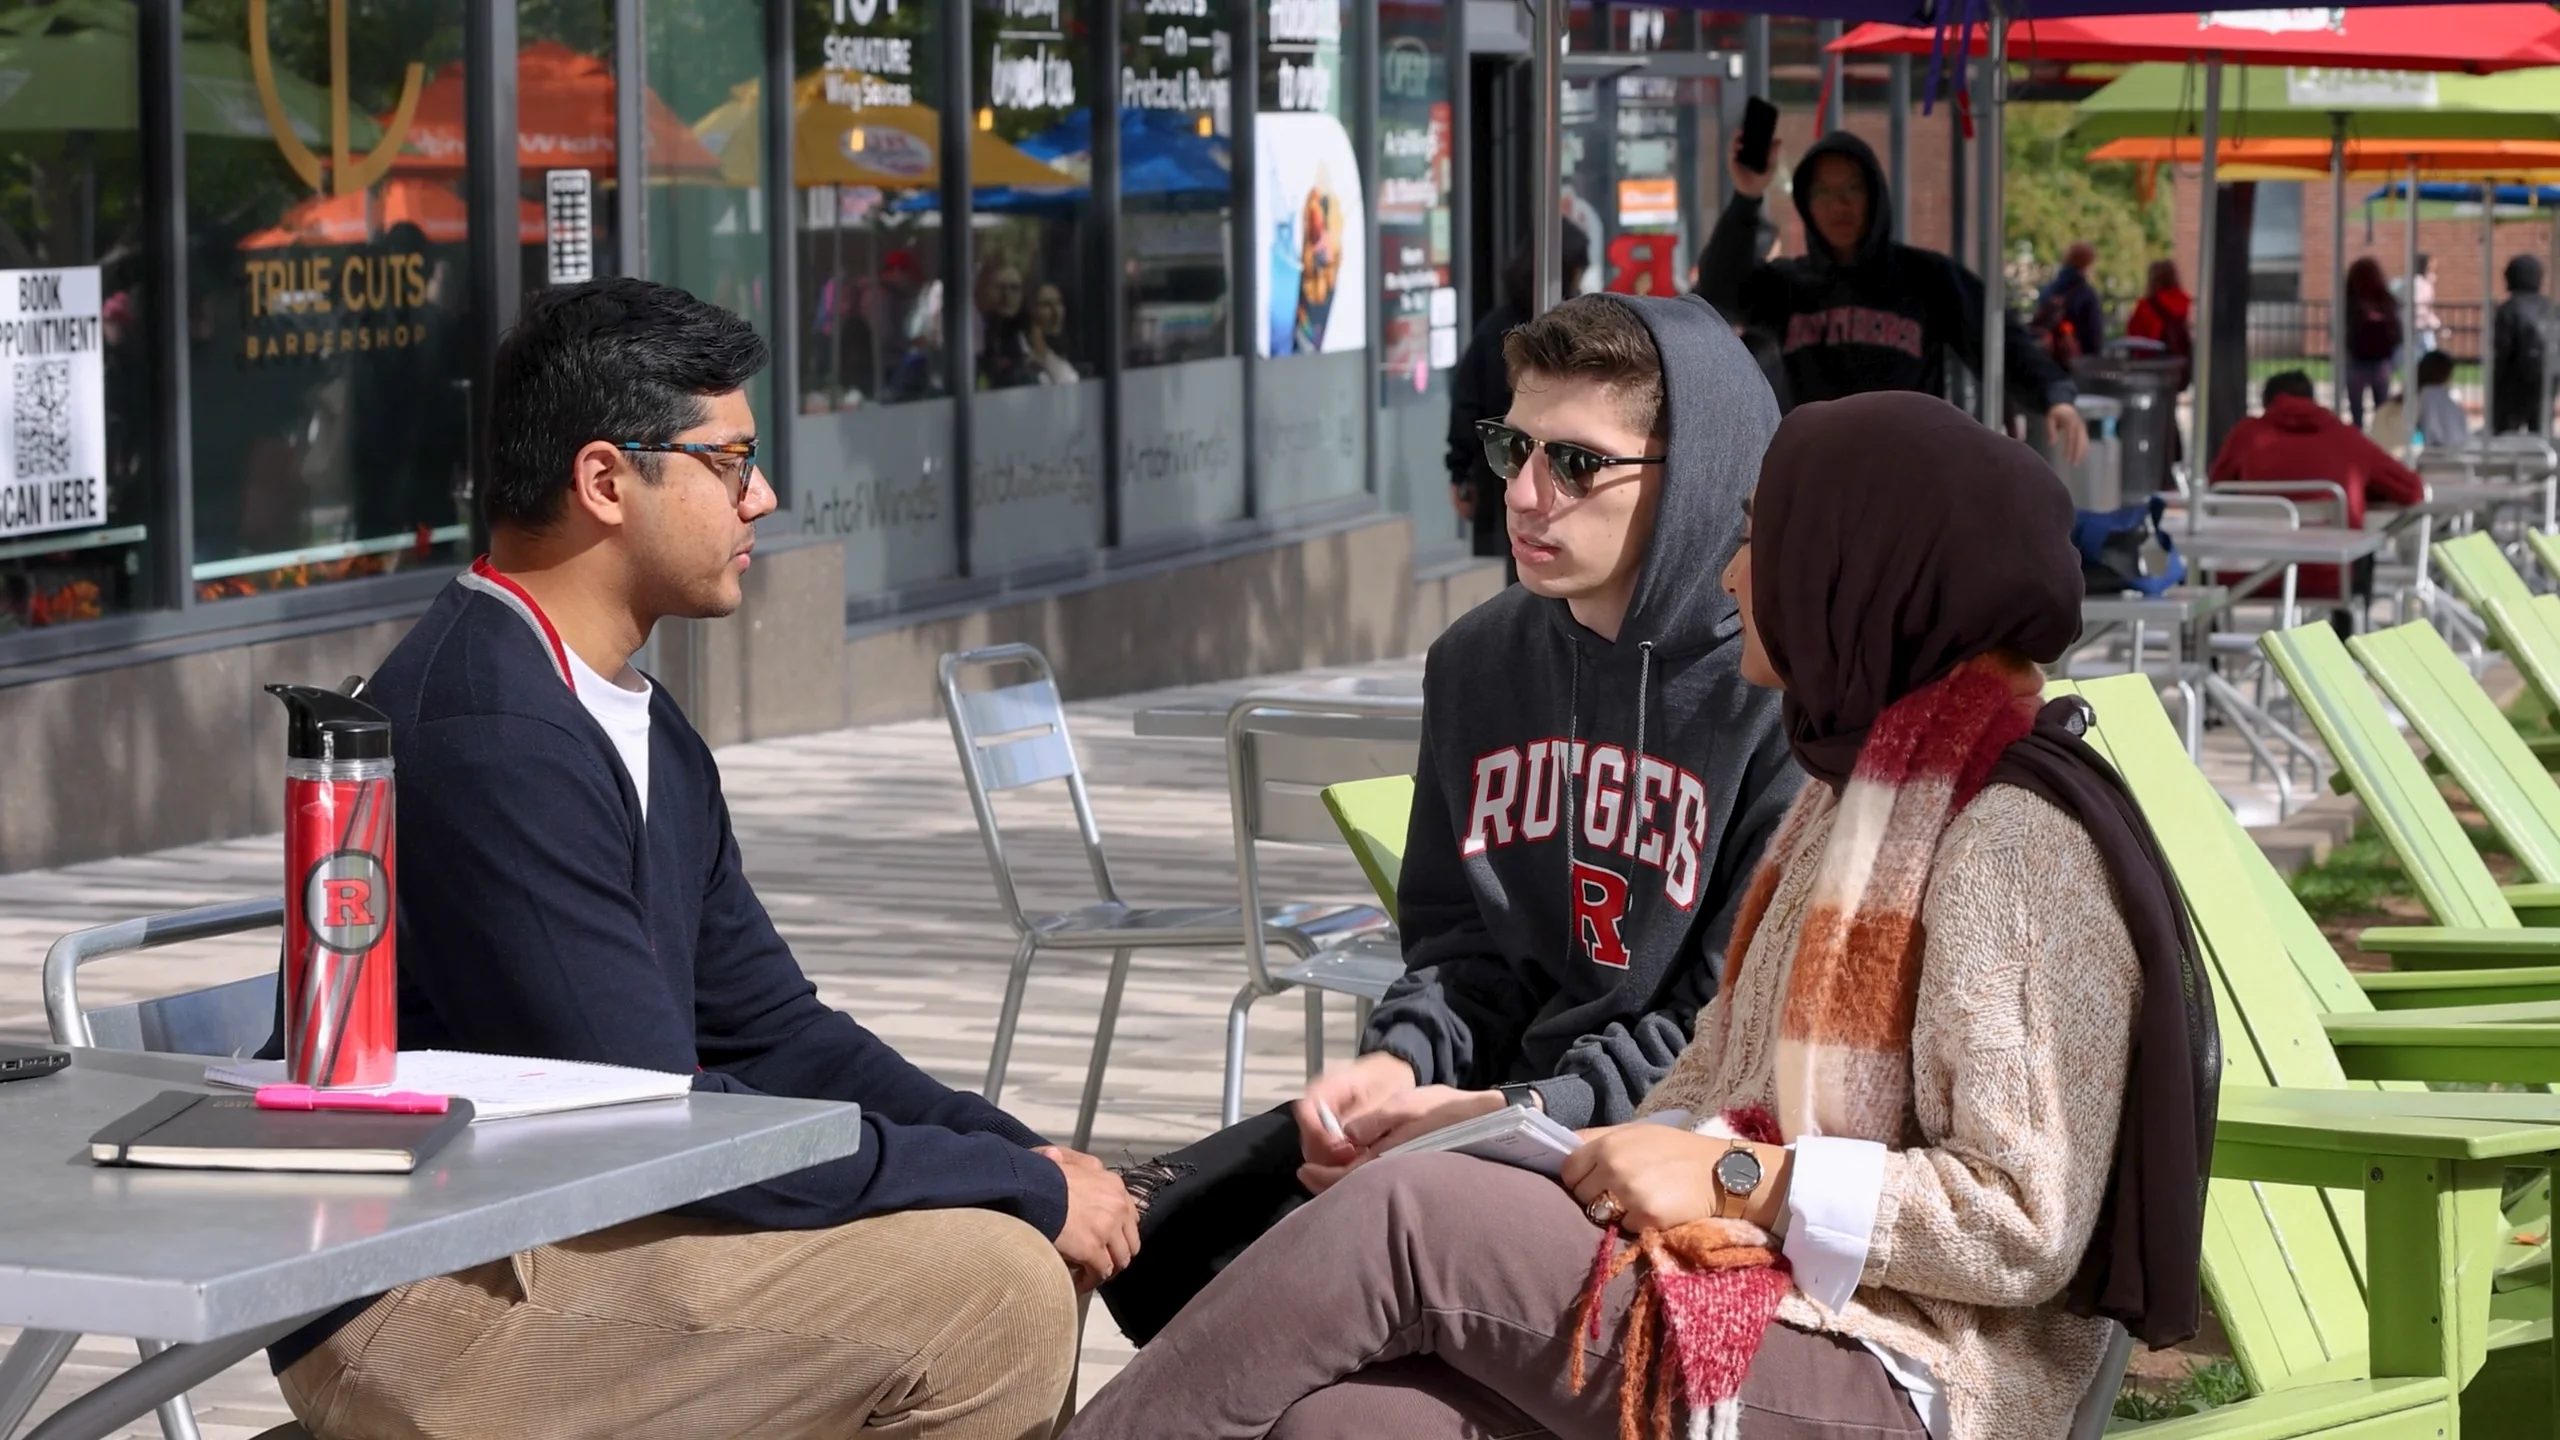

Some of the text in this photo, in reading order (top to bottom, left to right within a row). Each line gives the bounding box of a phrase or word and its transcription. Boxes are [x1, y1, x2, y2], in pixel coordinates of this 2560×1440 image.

[823, 35, 911, 74] SIGNATURE
[825, 73, 911, 112] Wing Sauces
[19, 276, 62, 311] BOOK
[246, 251, 426, 317] TRUE CUTS
[246, 324, 426, 360] BARBERSHOP
[0, 478, 97, 528] CAN HERE
[323, 878, 375, 927] R
[1572, 858, 1633, 970] R
